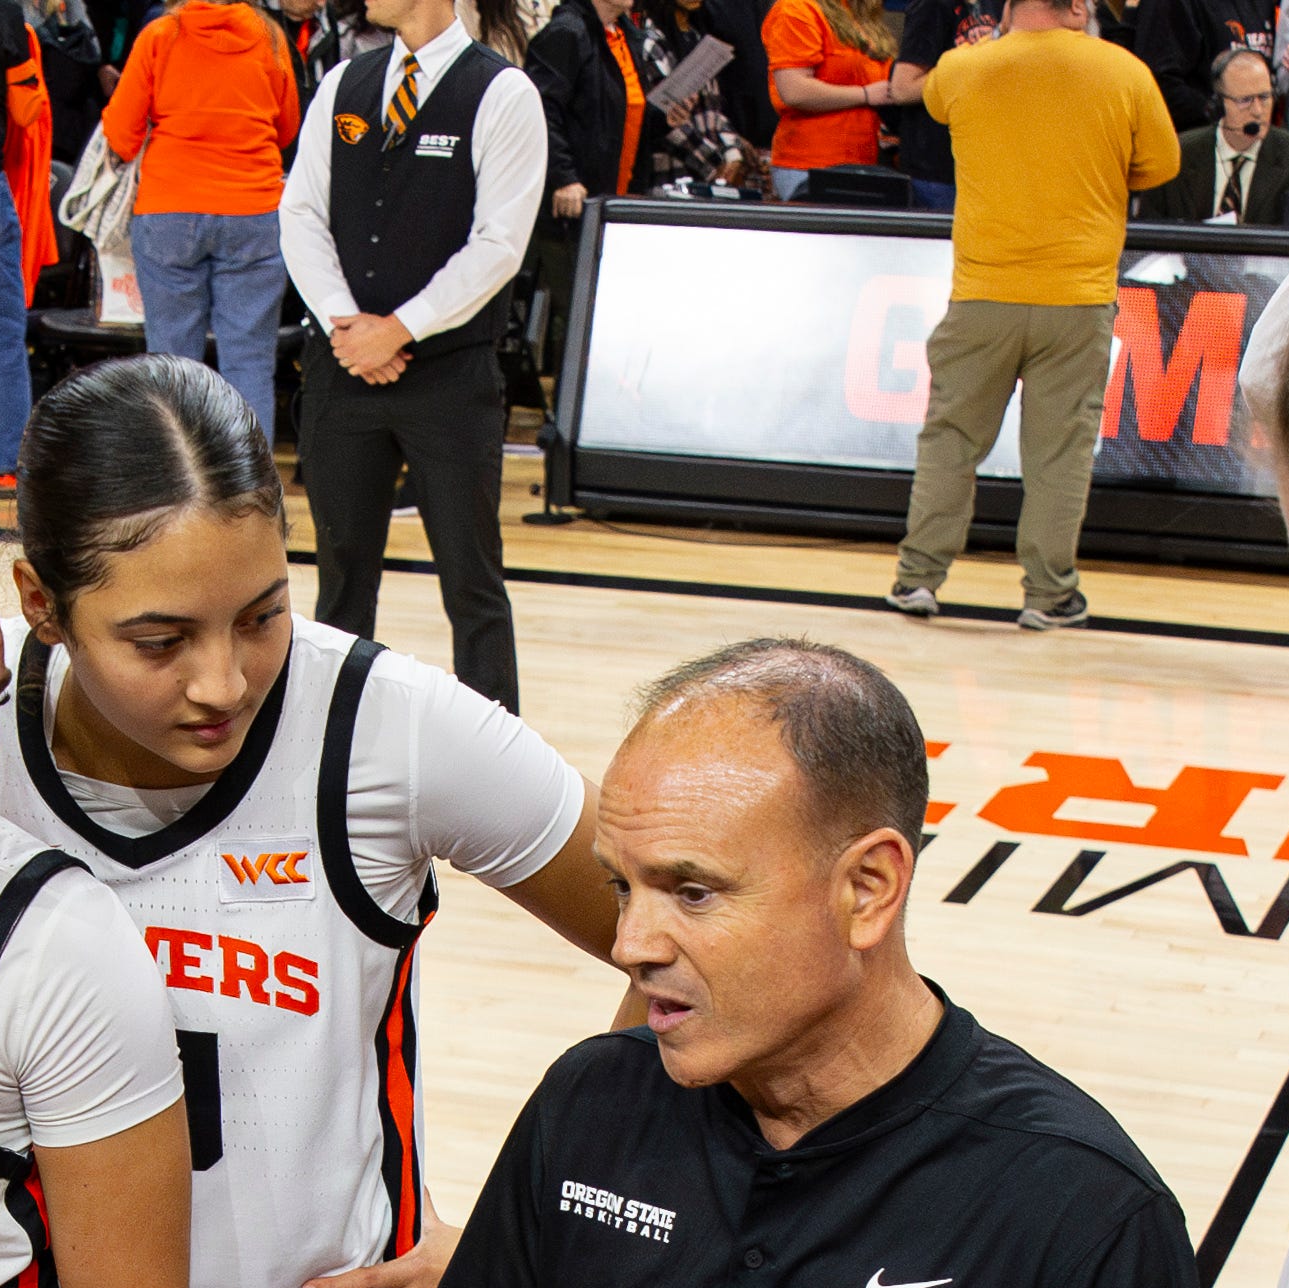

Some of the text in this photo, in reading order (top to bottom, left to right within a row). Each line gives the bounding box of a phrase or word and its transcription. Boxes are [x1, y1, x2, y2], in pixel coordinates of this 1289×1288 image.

[220, 851, 311, 886] WCC
[560, 1200, 670, 1243] BASKETBALL
[561, 1180, 676, 1231] OREGON STATE
